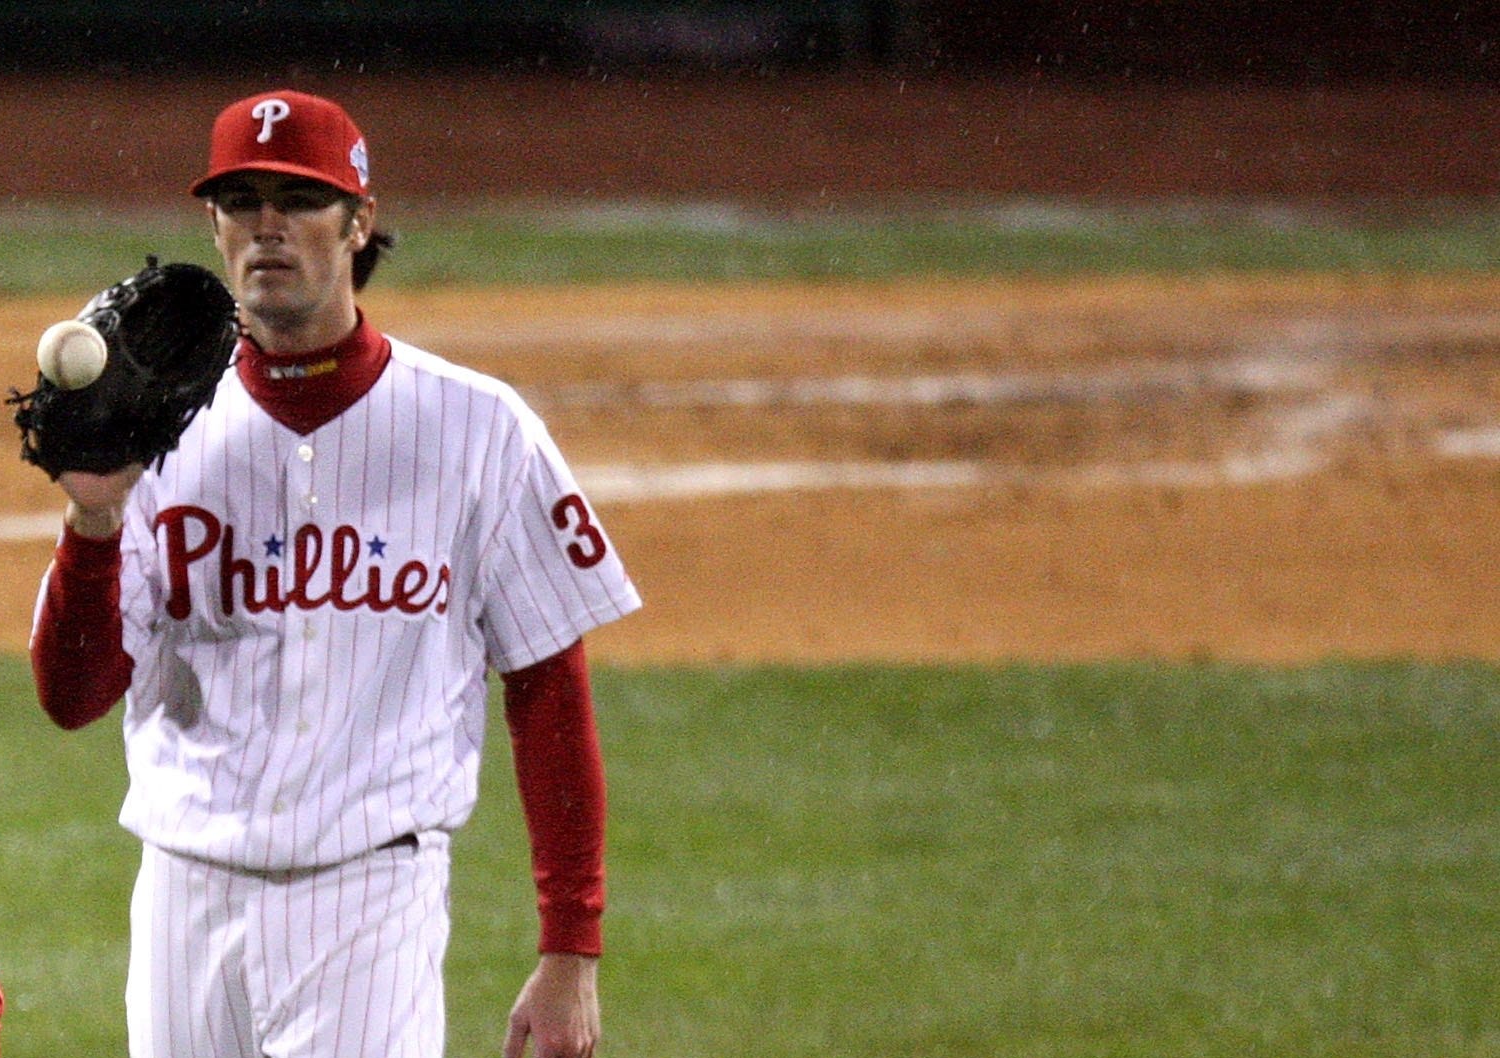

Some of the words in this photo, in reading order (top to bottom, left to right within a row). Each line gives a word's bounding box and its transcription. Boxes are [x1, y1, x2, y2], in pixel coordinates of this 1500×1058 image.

[252, 98, 291, 144] P
[156, 504, 450, 621] Phillies
[551, 494, 606, 569] 3
